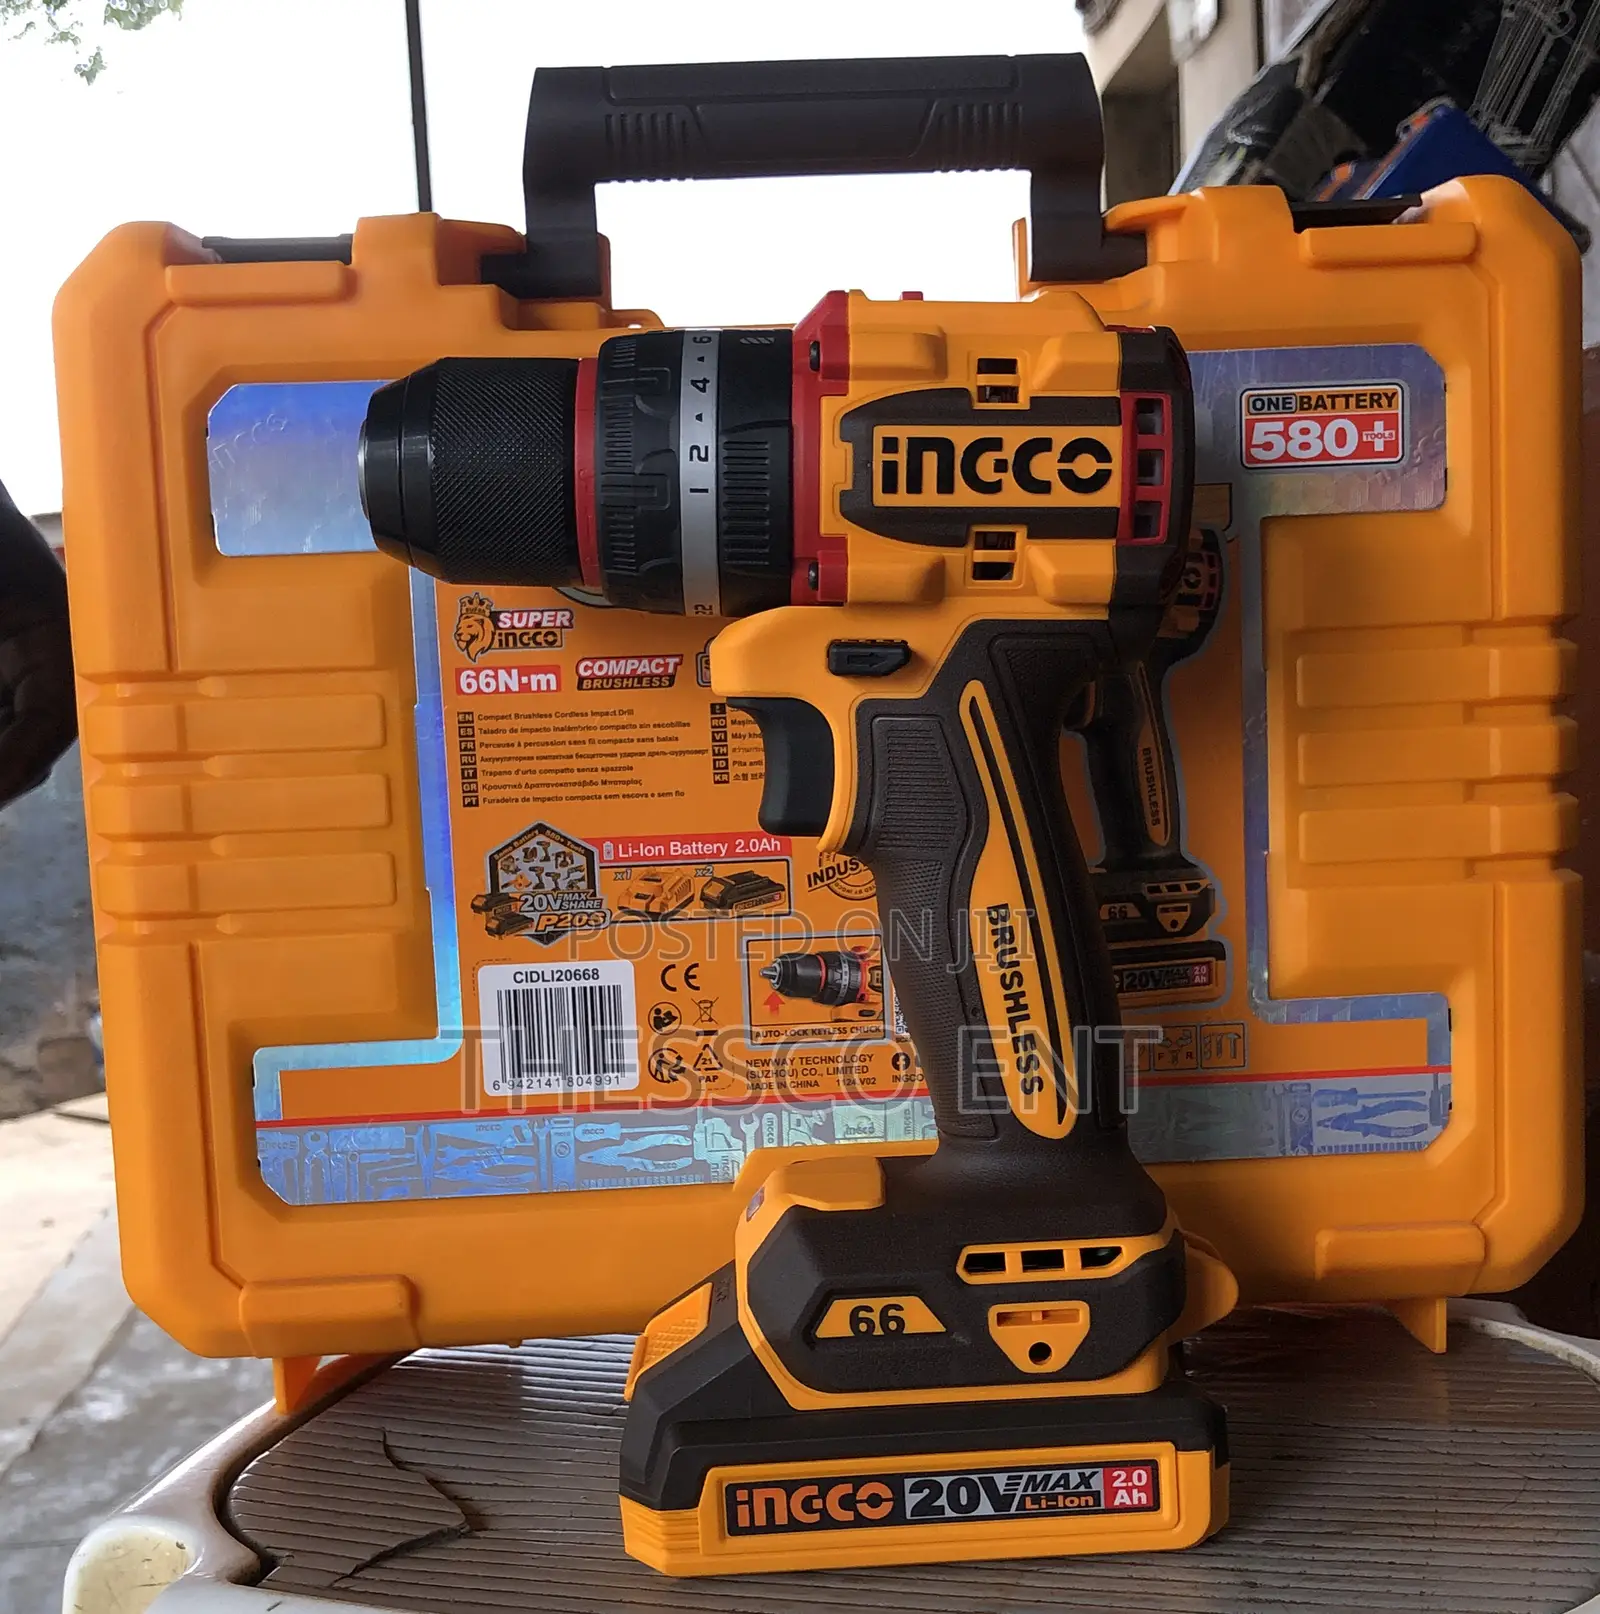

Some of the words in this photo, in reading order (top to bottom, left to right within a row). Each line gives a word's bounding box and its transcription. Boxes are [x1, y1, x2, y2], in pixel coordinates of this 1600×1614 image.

[690, 377, 710, 394] 4
[1251, 396, 1294, 412] ONE
[1296, 392, 1398, 411] BATTERY
[1364, 431, 1394, 441] TOOLS
[689, 444, 710, 463] 2
[497, 611, 571, 629] SUPER
[578, 657, 680, 677] COMPACT
[582, 677, 671, 689] BRUSHLESS
[459, 713, 473, 722] EN
[477, 712, 512, 722] Compact
[514, 711, 552, 720] Brushless
[554, 709, 588, 718] Cordless
[590, 708, 617, 717] Impact
[618, 708, 634, 716] Drill
[711, 718, 726, 727] RO
[460, 727, 473, 736] ES
[478, 727, 507, 735] Taladro
[509, 726, 518, 734] de
[520, 725, 551, 735] impacto
[600, 723, 637, 732] compacto
[639, 721, 651, 729] sin
[652, 720, 691, 729] escobillas
[461, 741, 475, 750] FR
[479, 741, 515, 749] Perceuse
[523, 738, 566, 748] percussion
[597, 737, 635, 747] compacte
[713, 746, 727, 755] TH
[461, 755, 475, 764] RU
[715, 760, 726, 768] ID
[464, 769, 475, 777] IT
[481, 769, 512, 778] Trapano
[538, 767, 575, 776] compatto
[576, 766, 598, 774] senza
[600, 765, 634, 774] spazzole
[714, 773, 728, 782] KR
[464, 796, 478, 805] PT
[482, 796, 519, 805] Furadeira
[521, 795, 531, 803] de
[532, 794, 563, 804] impacto
[565, 794, 602, 803] compacta
[674, 789, 685, 797] fio
[513, 829, 540, 847] Battery
[618, 843, 665, 858] Li-Ion
[670, 840, 728, 858] Battery
[735, 838, 781, 853] 2.0Ah
[520, 893, 561, 911] 20V
[561, 900, 601, 910] SHARE
[1107, 905, 1128, 921] 66
[536, 912, 606, 932] P20S
[513, 967, 600, 985] CIDLI20668
[986, 903, 1044, 1095] BRUSHLESS
[755, 1028, 809, 1039] AUTO-LOCK
[811, 1026, 848, 1037] KEYLESS
[850, 1024, 881, 1035] CHUCK
[745, 1056, 796, 1068] NEWWAY
[798, 1053, 874, 1066] TECHNOLOGY
[698, 1075, 720, 1084] PAP
[745, 1068, 799, 1080] (SUZHOU)
[826, 1065, 869, 1076] LIMITED
[891, 1073, 925, 1083] INGCO
[492, 1079, 501, 1091] 6
[507, 1076, 561, 1091] 942141
[567, 1074, 621, 1088] 804991
[746, 1081, 774, 1091] MADE
[776, 1081, 787, 1090] IN
[790, 1080, 820, 1089] CHINA
[849, 1304, 906, 1336] 66
[909, 1474, 1022, 1518] 20V
[1021, 1470, 1100, 1493] MAX
[1111, 1469, 1148, 1487] 2.0
[1024, 1493, 1094, 1510] Li-Ion
[1113, 1489, 1148, 1507] Ah
